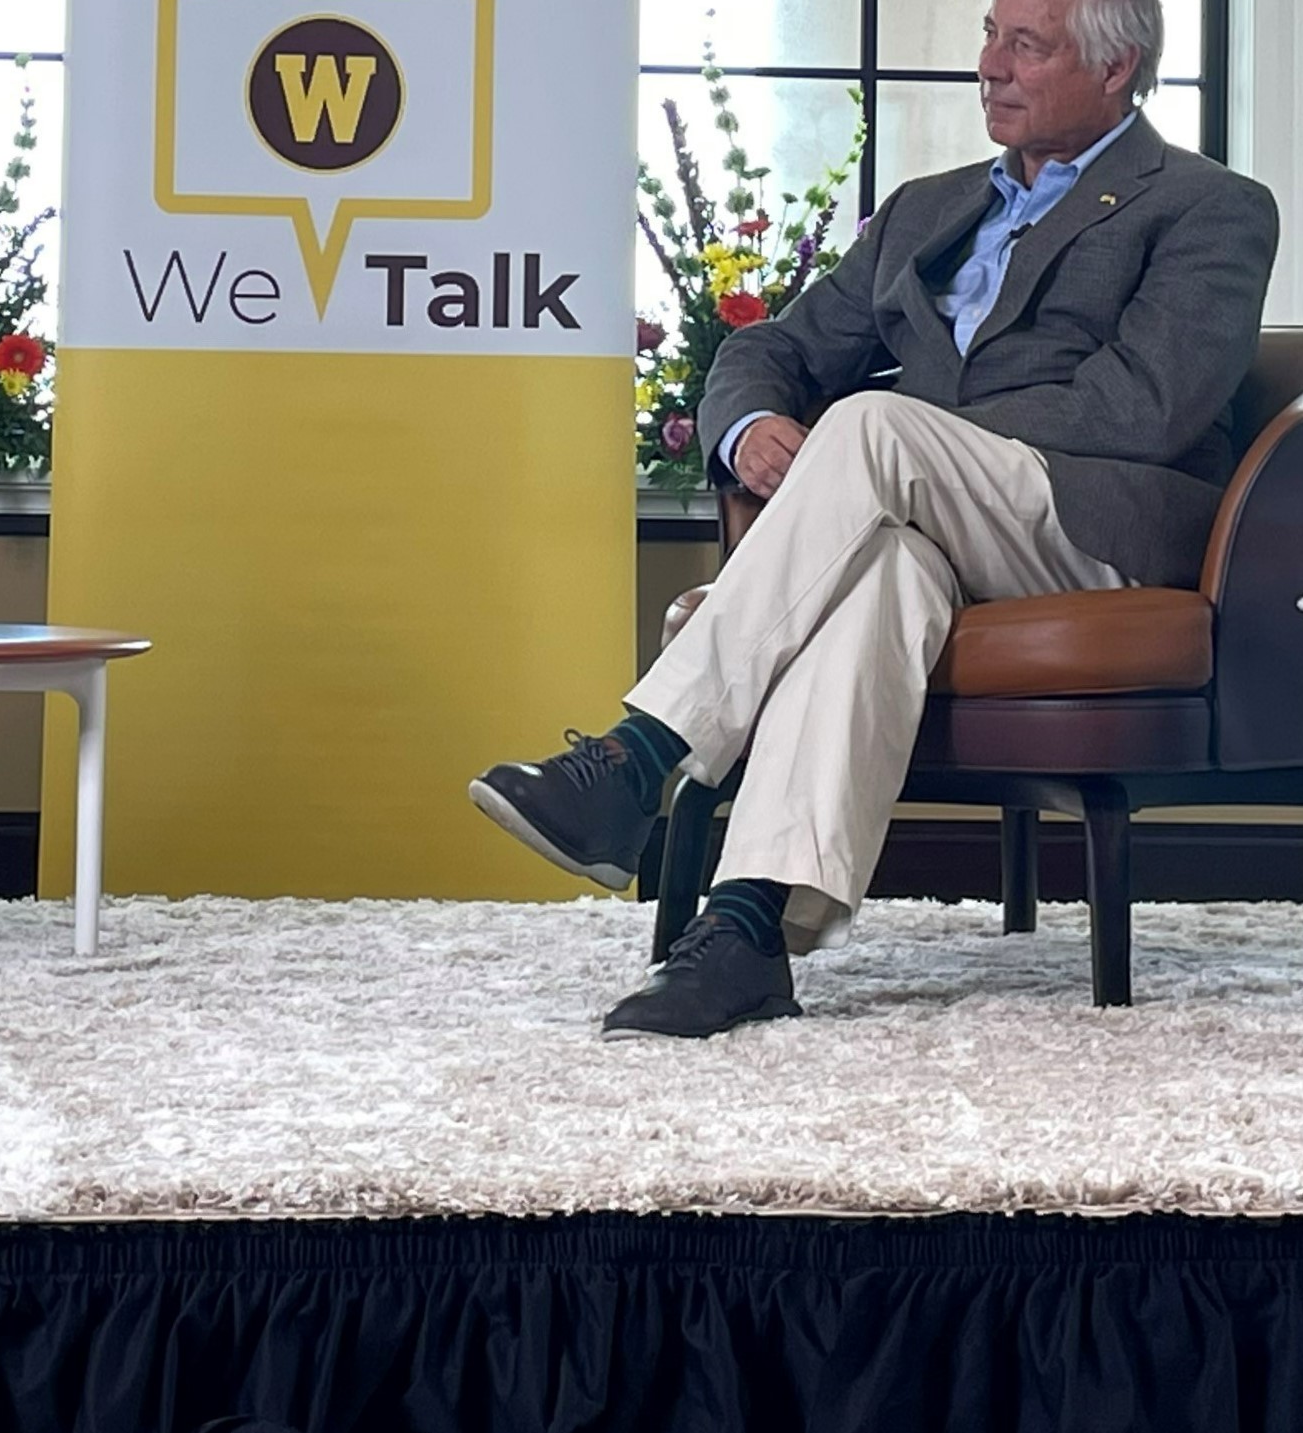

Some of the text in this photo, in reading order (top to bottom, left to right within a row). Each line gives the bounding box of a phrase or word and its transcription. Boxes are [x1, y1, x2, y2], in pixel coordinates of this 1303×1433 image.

[274, 53, 377, 144] W
[123, 249, 582, 330] We Talk
